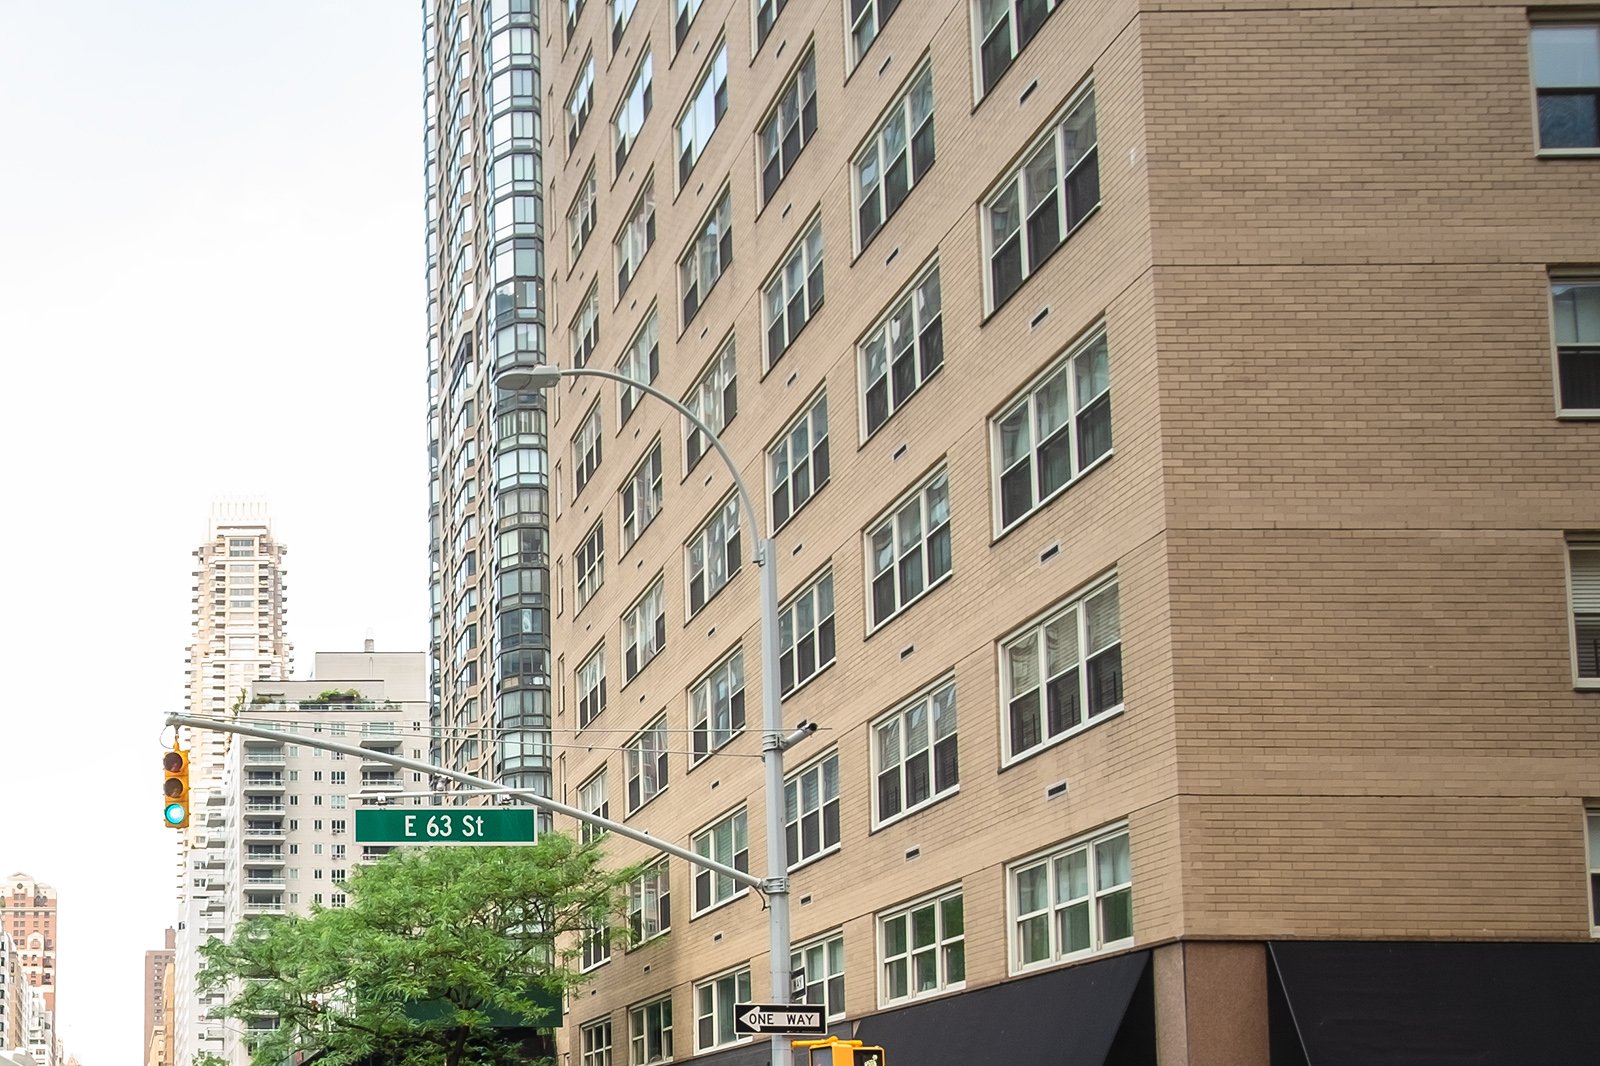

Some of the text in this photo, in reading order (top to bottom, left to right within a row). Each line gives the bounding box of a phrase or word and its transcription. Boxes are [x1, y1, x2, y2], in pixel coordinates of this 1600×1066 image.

[404, 815, 484, 837] E 63 St
[748, 1013, 815, 1026] ONE WAY
